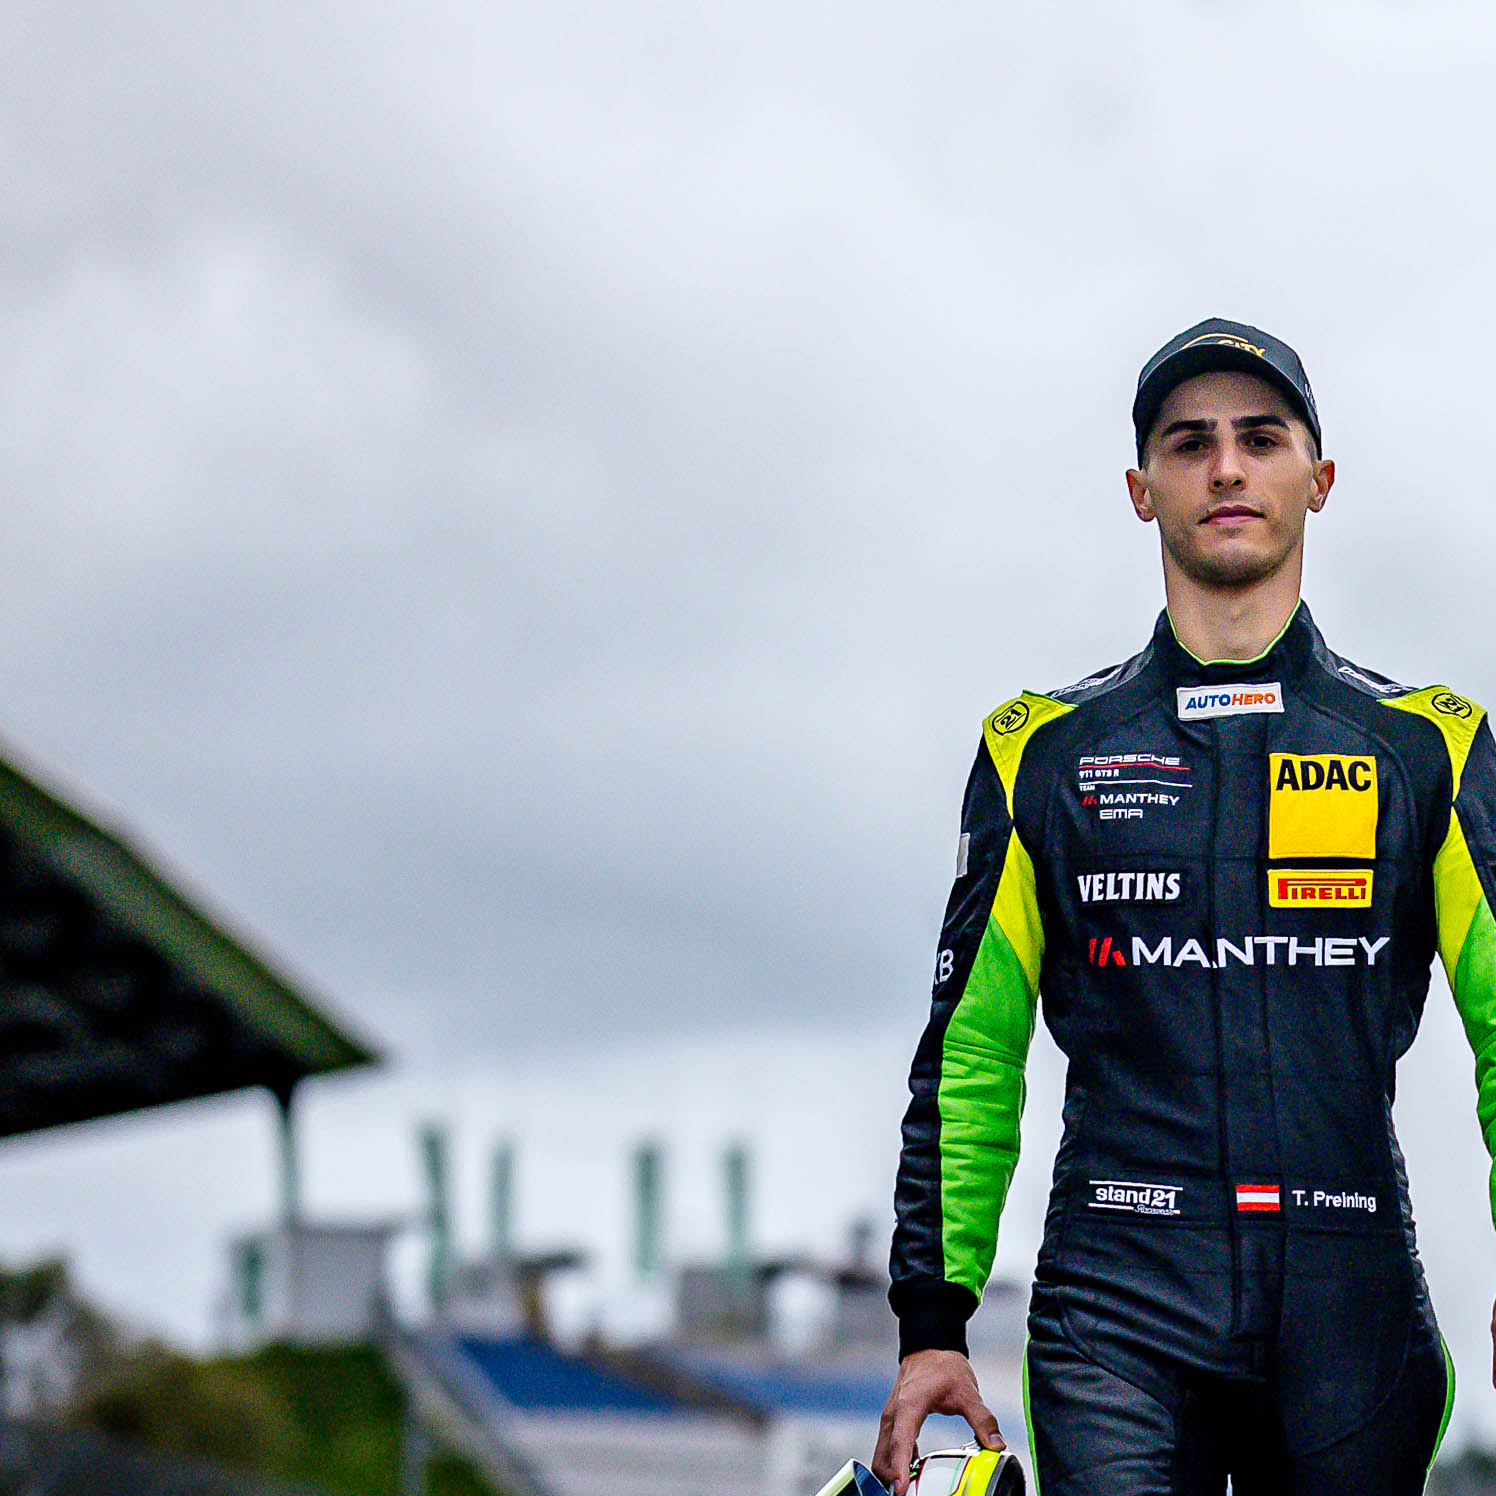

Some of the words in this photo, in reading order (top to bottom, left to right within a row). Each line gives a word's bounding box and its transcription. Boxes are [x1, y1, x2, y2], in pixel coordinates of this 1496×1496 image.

[1185, 691, 1276, 711] AUTOHERO
[1079, 753, 1181, 766] PORSCHE
[1275, 759, 1372, 792] ADAC
[1099, 793, 1180, 806] MANTHEY
[1099, 808, 1144, 820] EMA
[1077, 872, 1181, 902] VELTINS
[1277, 878, 1367, 900] PIRELLI
[1132, 936, 1391, 968] MANTHEY
[1291, 1189, 1309, 1207] T.
[1312, 1189, 1377, 1213] Preining
